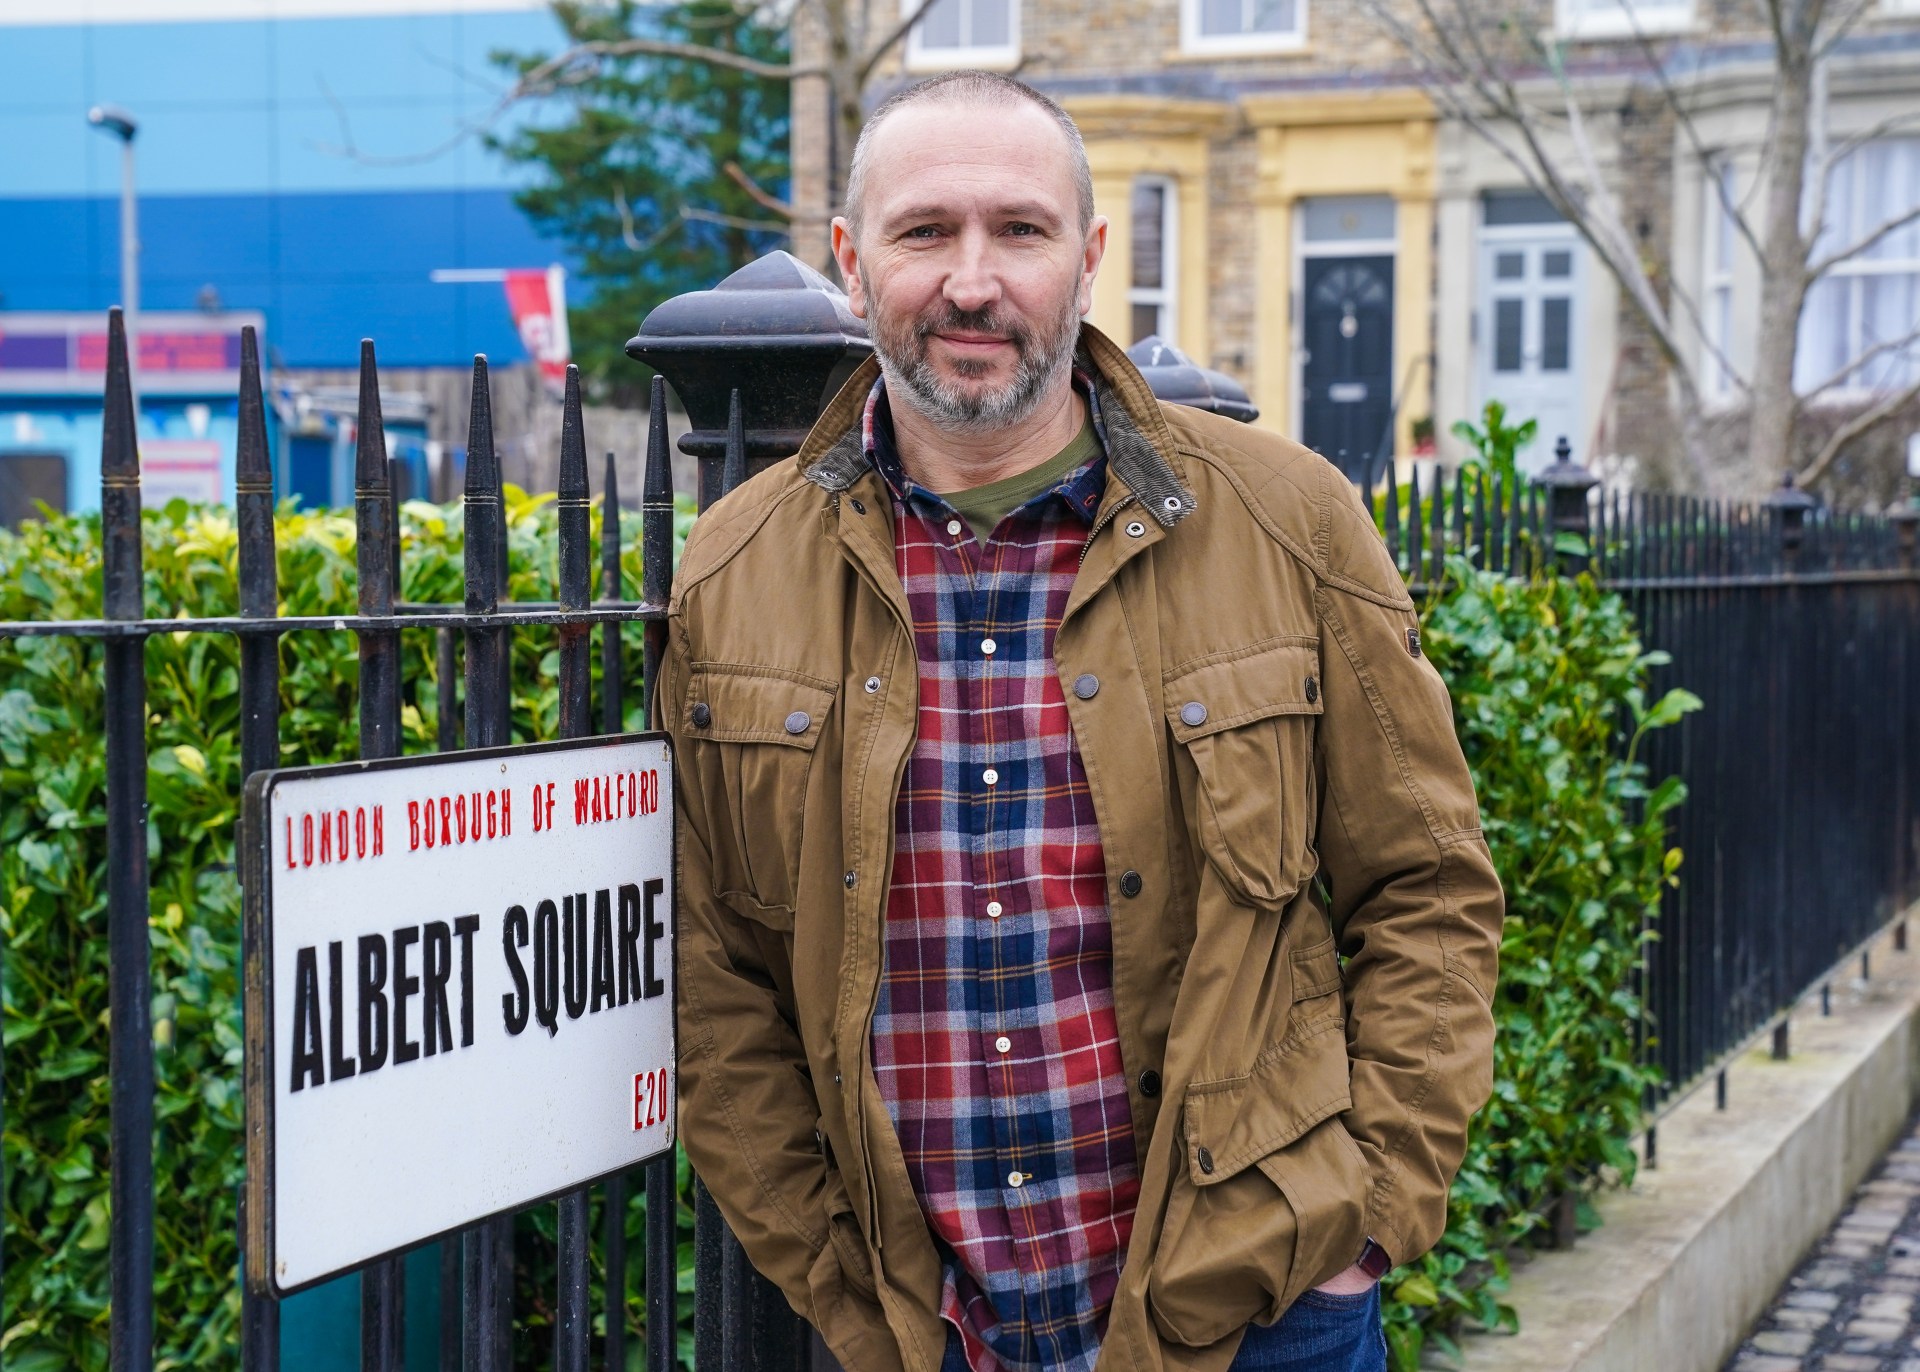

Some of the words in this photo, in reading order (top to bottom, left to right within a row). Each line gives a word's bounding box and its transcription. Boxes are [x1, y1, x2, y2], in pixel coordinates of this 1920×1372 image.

[286, 803, 384, 869] LONDON
[407, 788, 512, 851] BOROUGH
[532, 782, 556, 832] OF
[573, 768, 659, 826] WALFORD
[290, 913, 480, 1094] ALBERT
[502, 878, 664, 1039] SQUARE
[633, 1067, 667, 1131] E20
